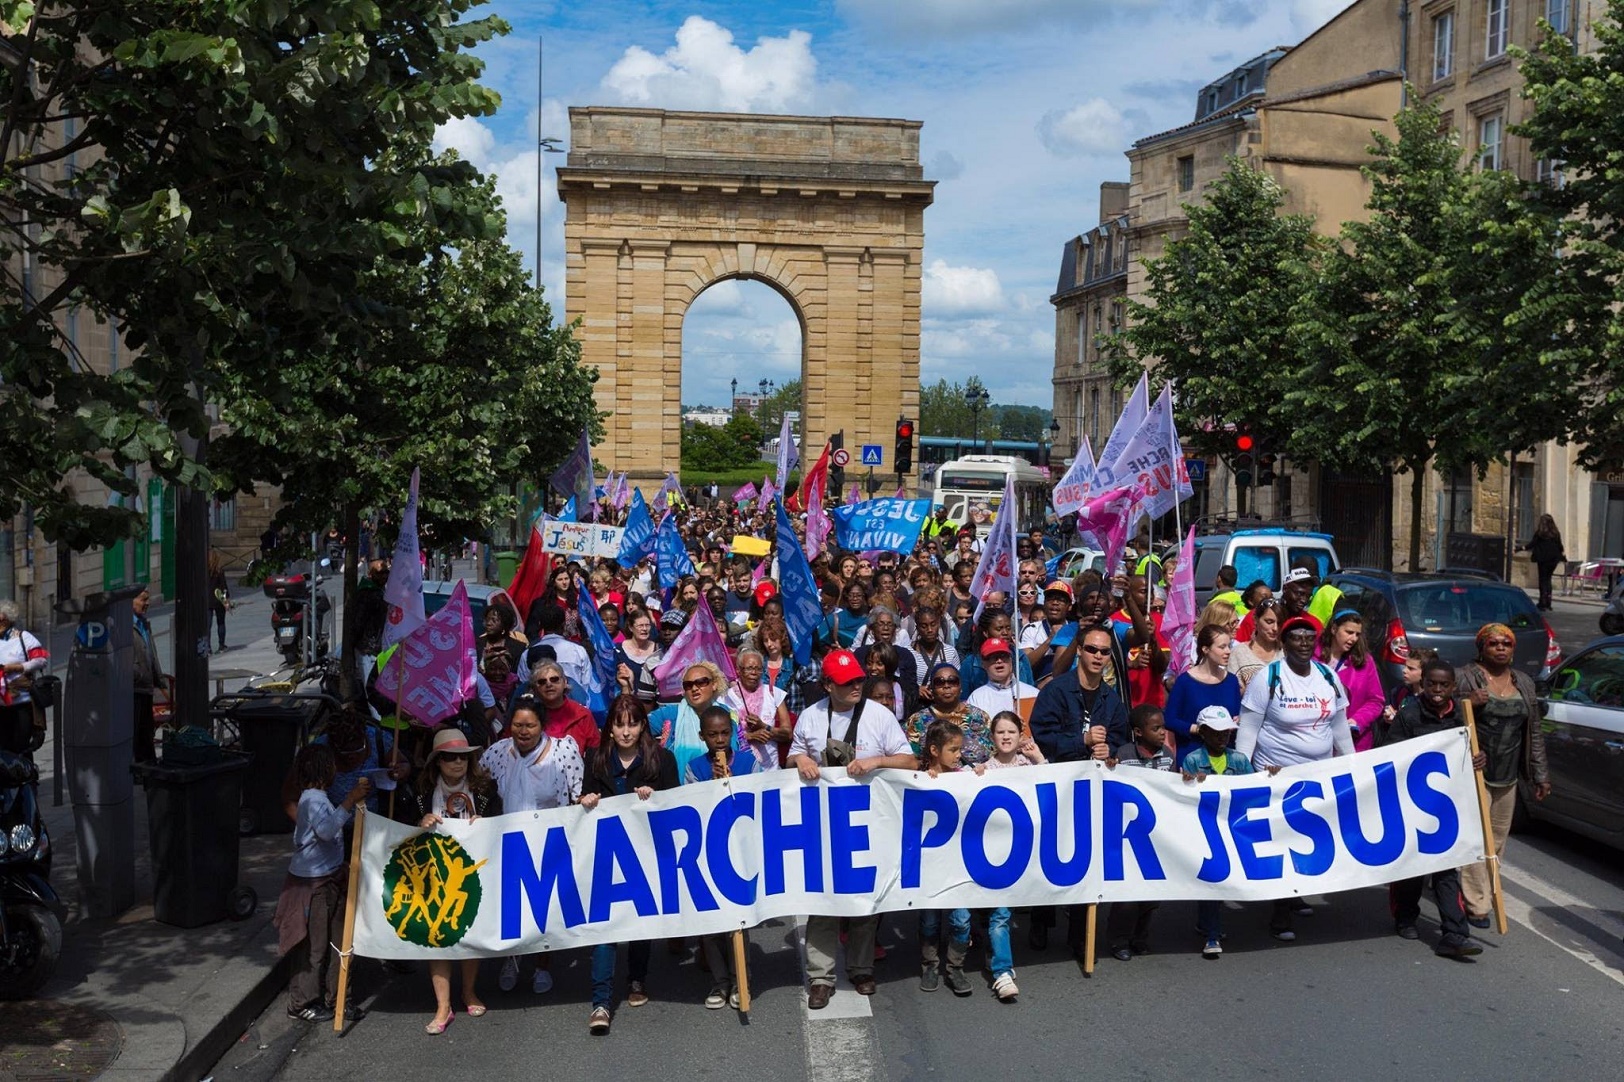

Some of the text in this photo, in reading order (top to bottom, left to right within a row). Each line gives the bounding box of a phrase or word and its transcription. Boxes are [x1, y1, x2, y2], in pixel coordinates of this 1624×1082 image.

[548, 530, 585, 552] Jésus
[87, 621, 105, 648] P
[501, 751, 1459, 940] MARCHE POUR JESUS
